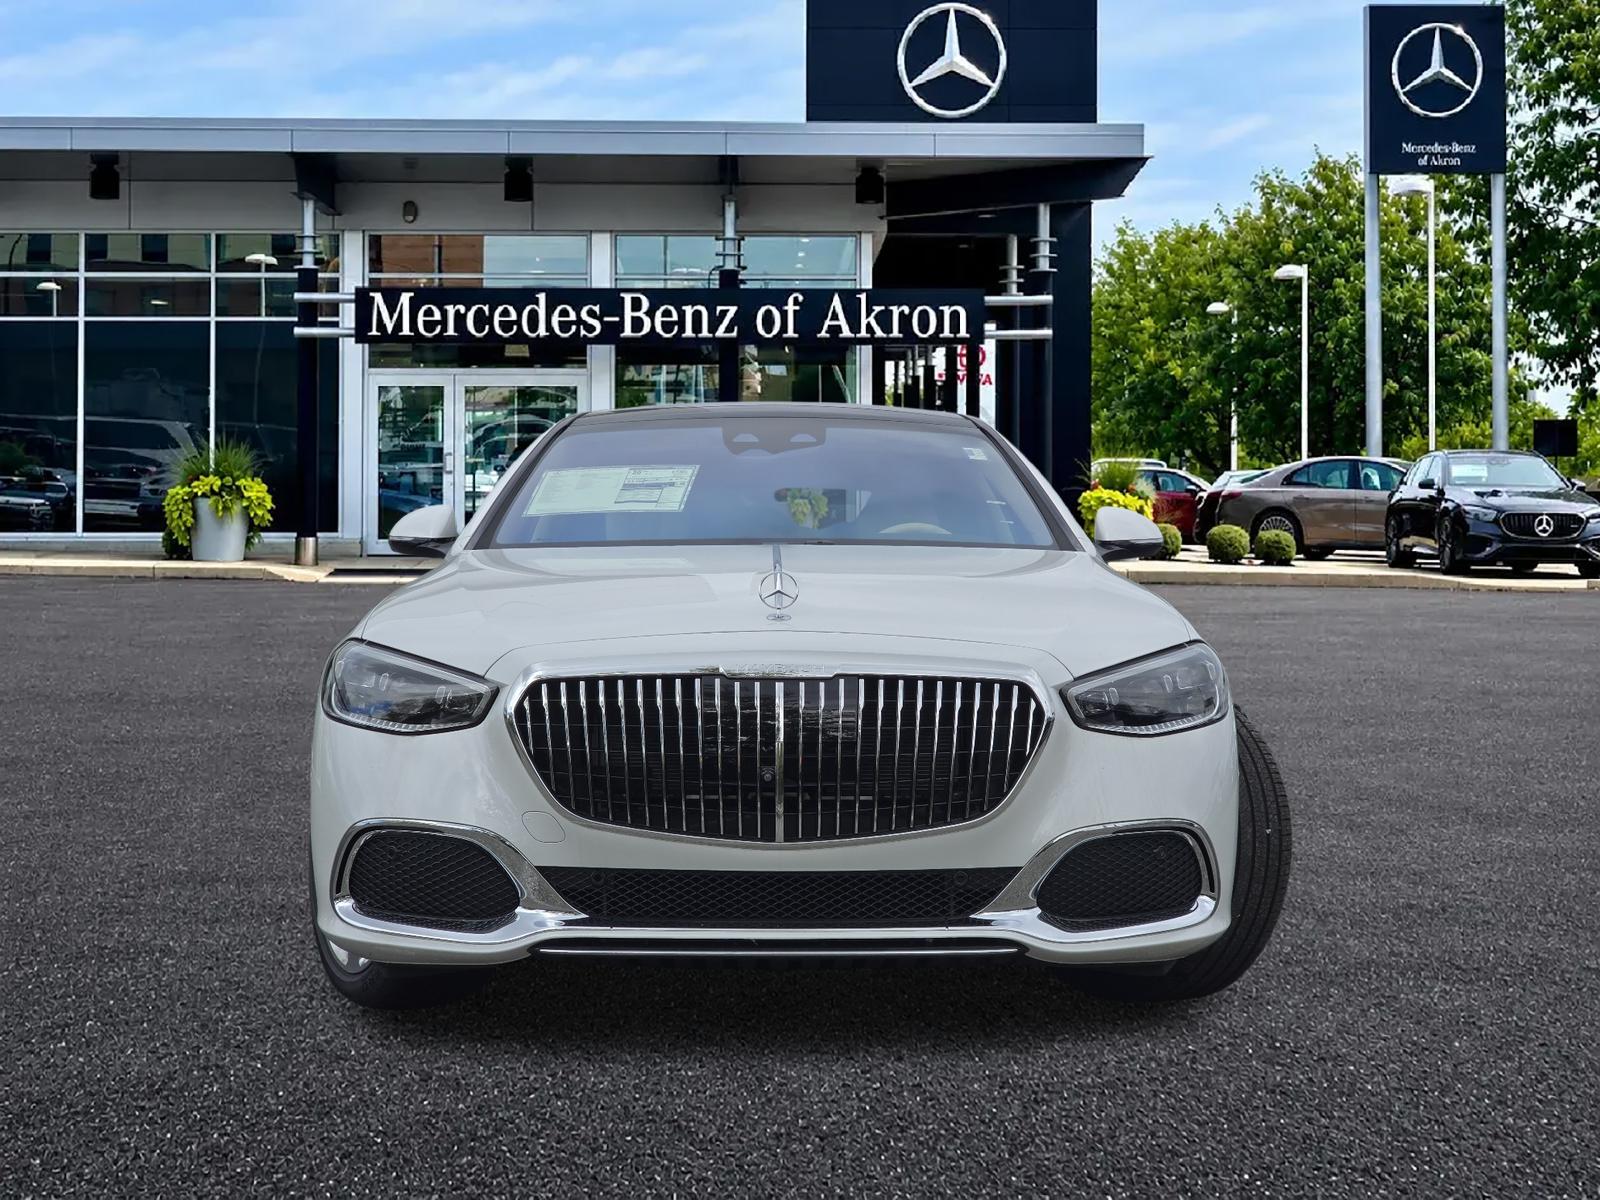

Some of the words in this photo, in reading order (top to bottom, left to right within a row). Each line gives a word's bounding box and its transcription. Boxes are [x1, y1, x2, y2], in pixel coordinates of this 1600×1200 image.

[1401, 141, 1477, 153] Mercedes-Benz
[1417, 154, 1428, 166] of
[1430, 154, 1461, 166] Akron
[367, 292, 738, 338] Mercedes-Benz
[756, 292, 804, 338] of
[817, 292, 970, 338] Akron
